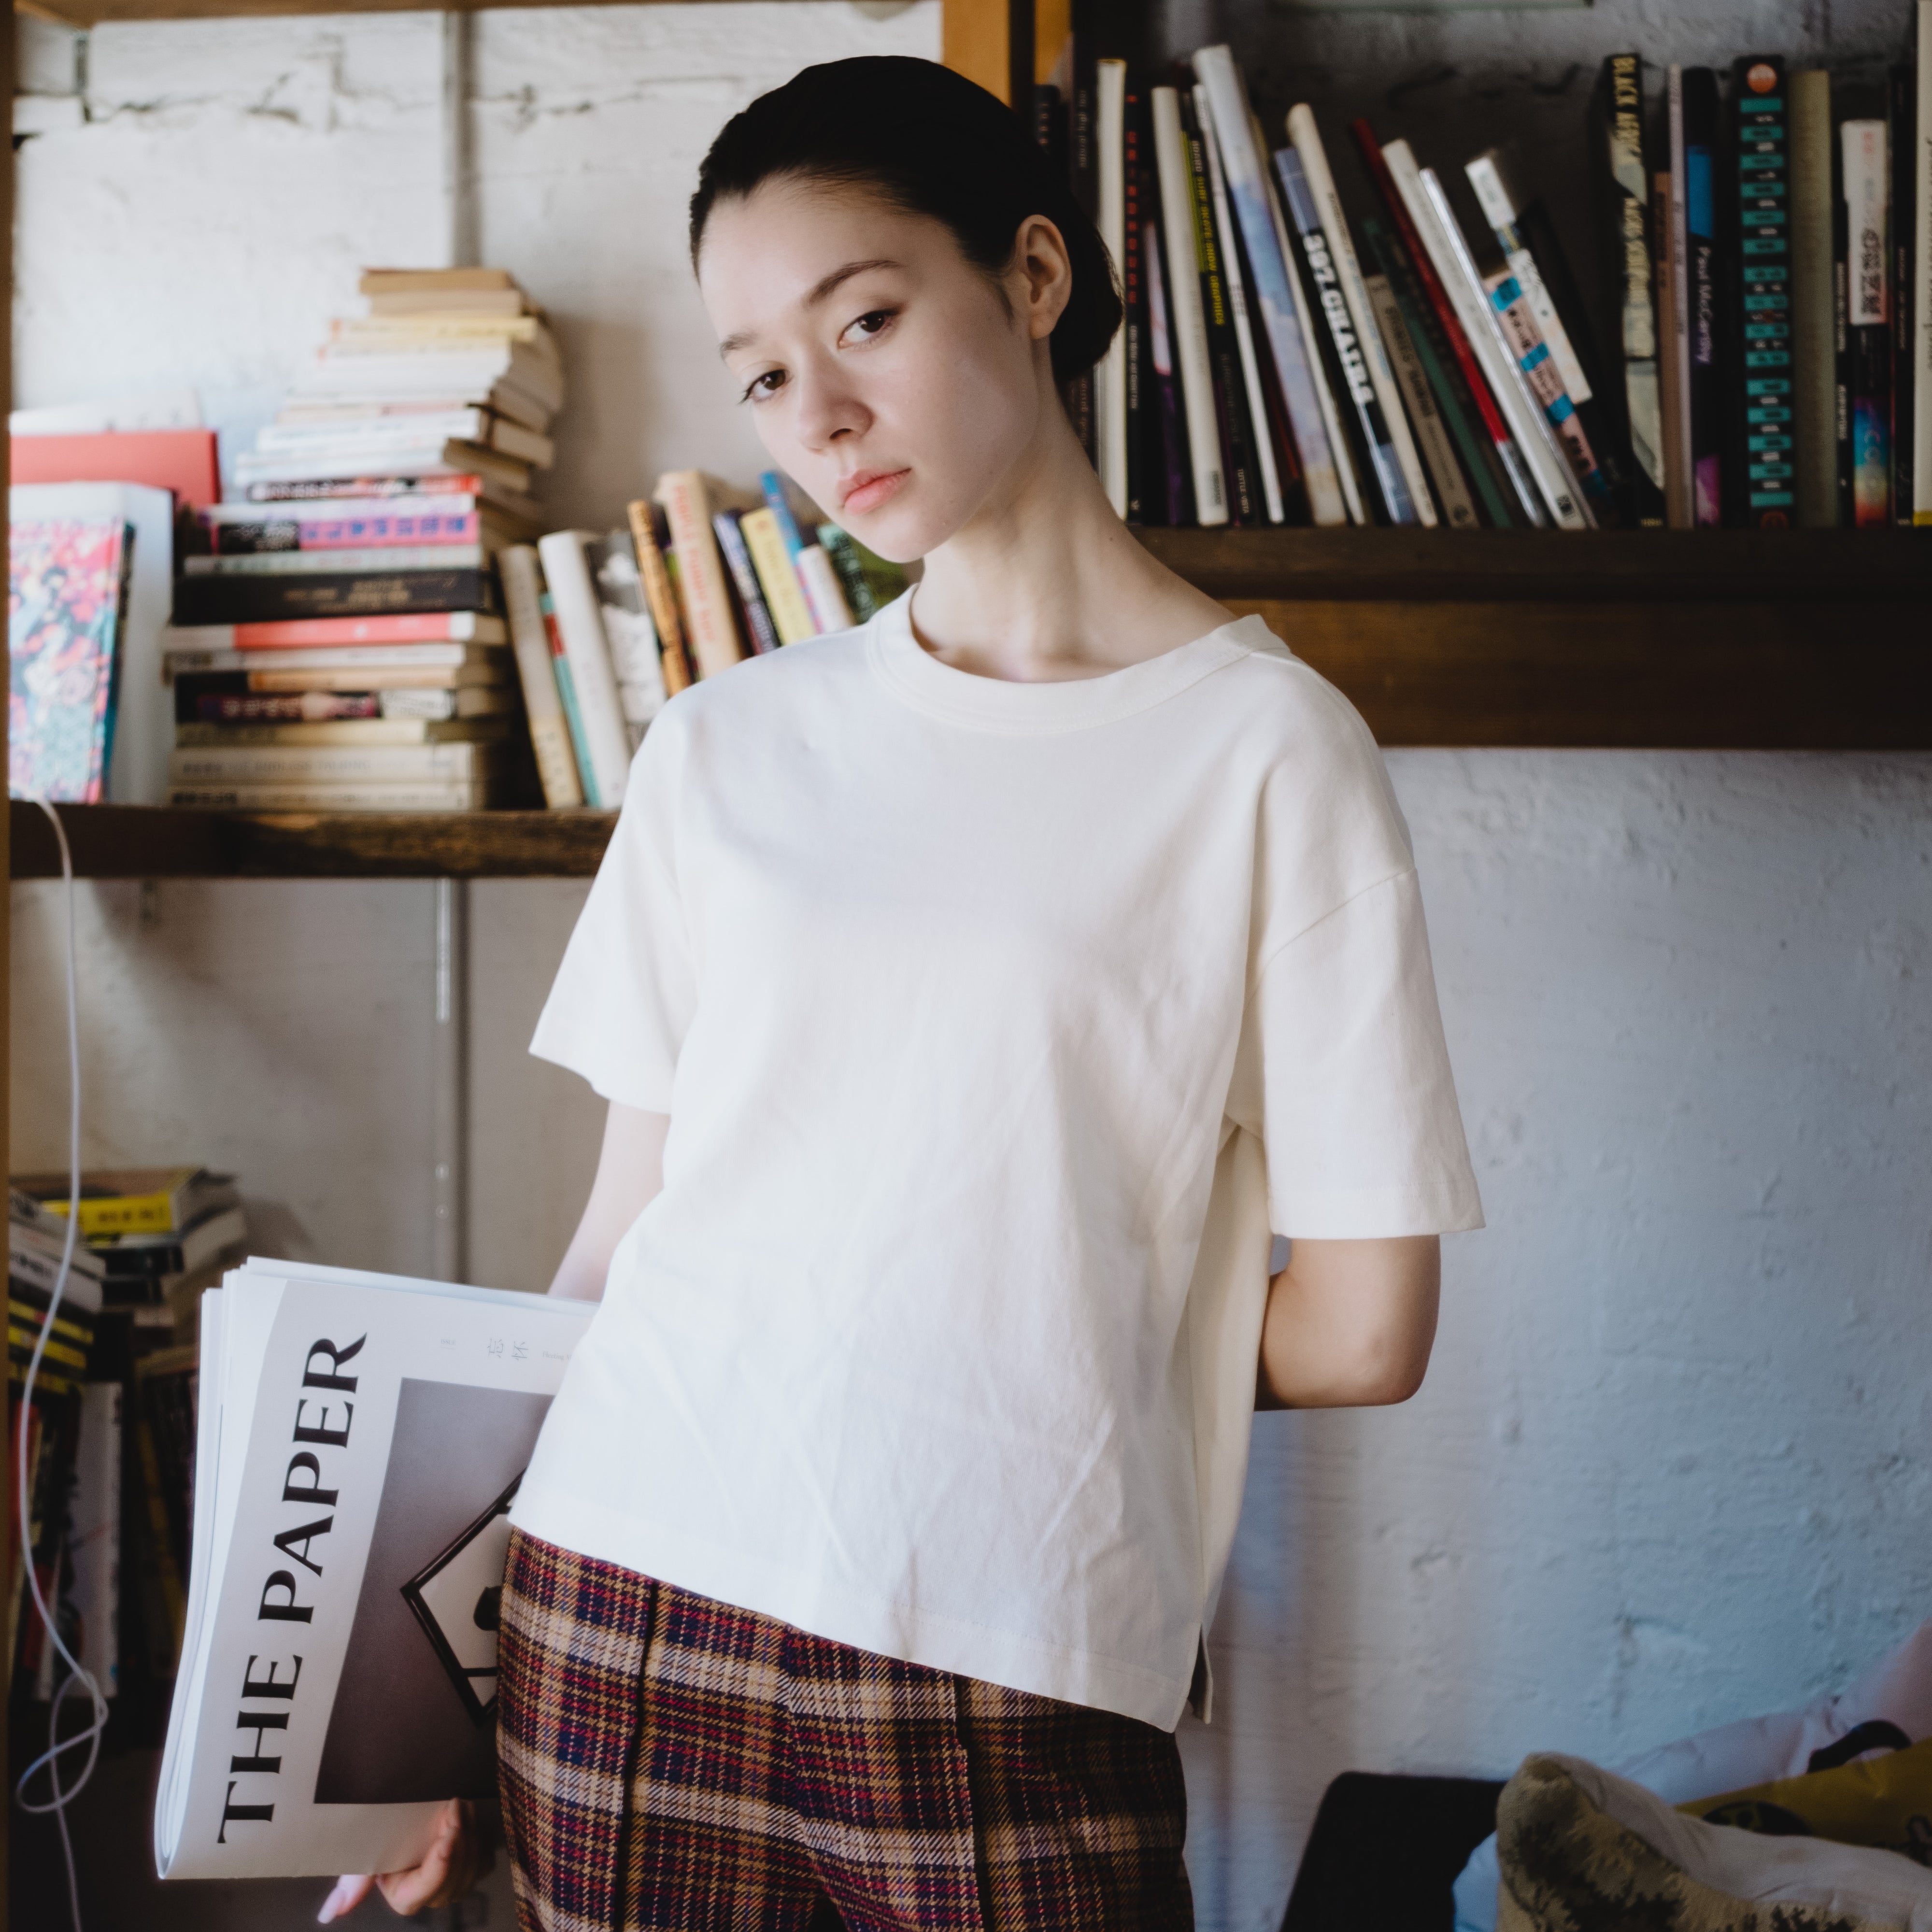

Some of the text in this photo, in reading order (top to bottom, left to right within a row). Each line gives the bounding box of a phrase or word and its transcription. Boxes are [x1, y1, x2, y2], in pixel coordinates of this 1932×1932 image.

[1193, 141, 1203, 172] BOARD
[1210, 275, 1225, 326] GRAPHICS
[1694, 246, 1713, 364] Paul McCarthy
[1321, 288, 1374, 406] CHAIRS
[217, 1332, 368, 1844] THE PAPER
